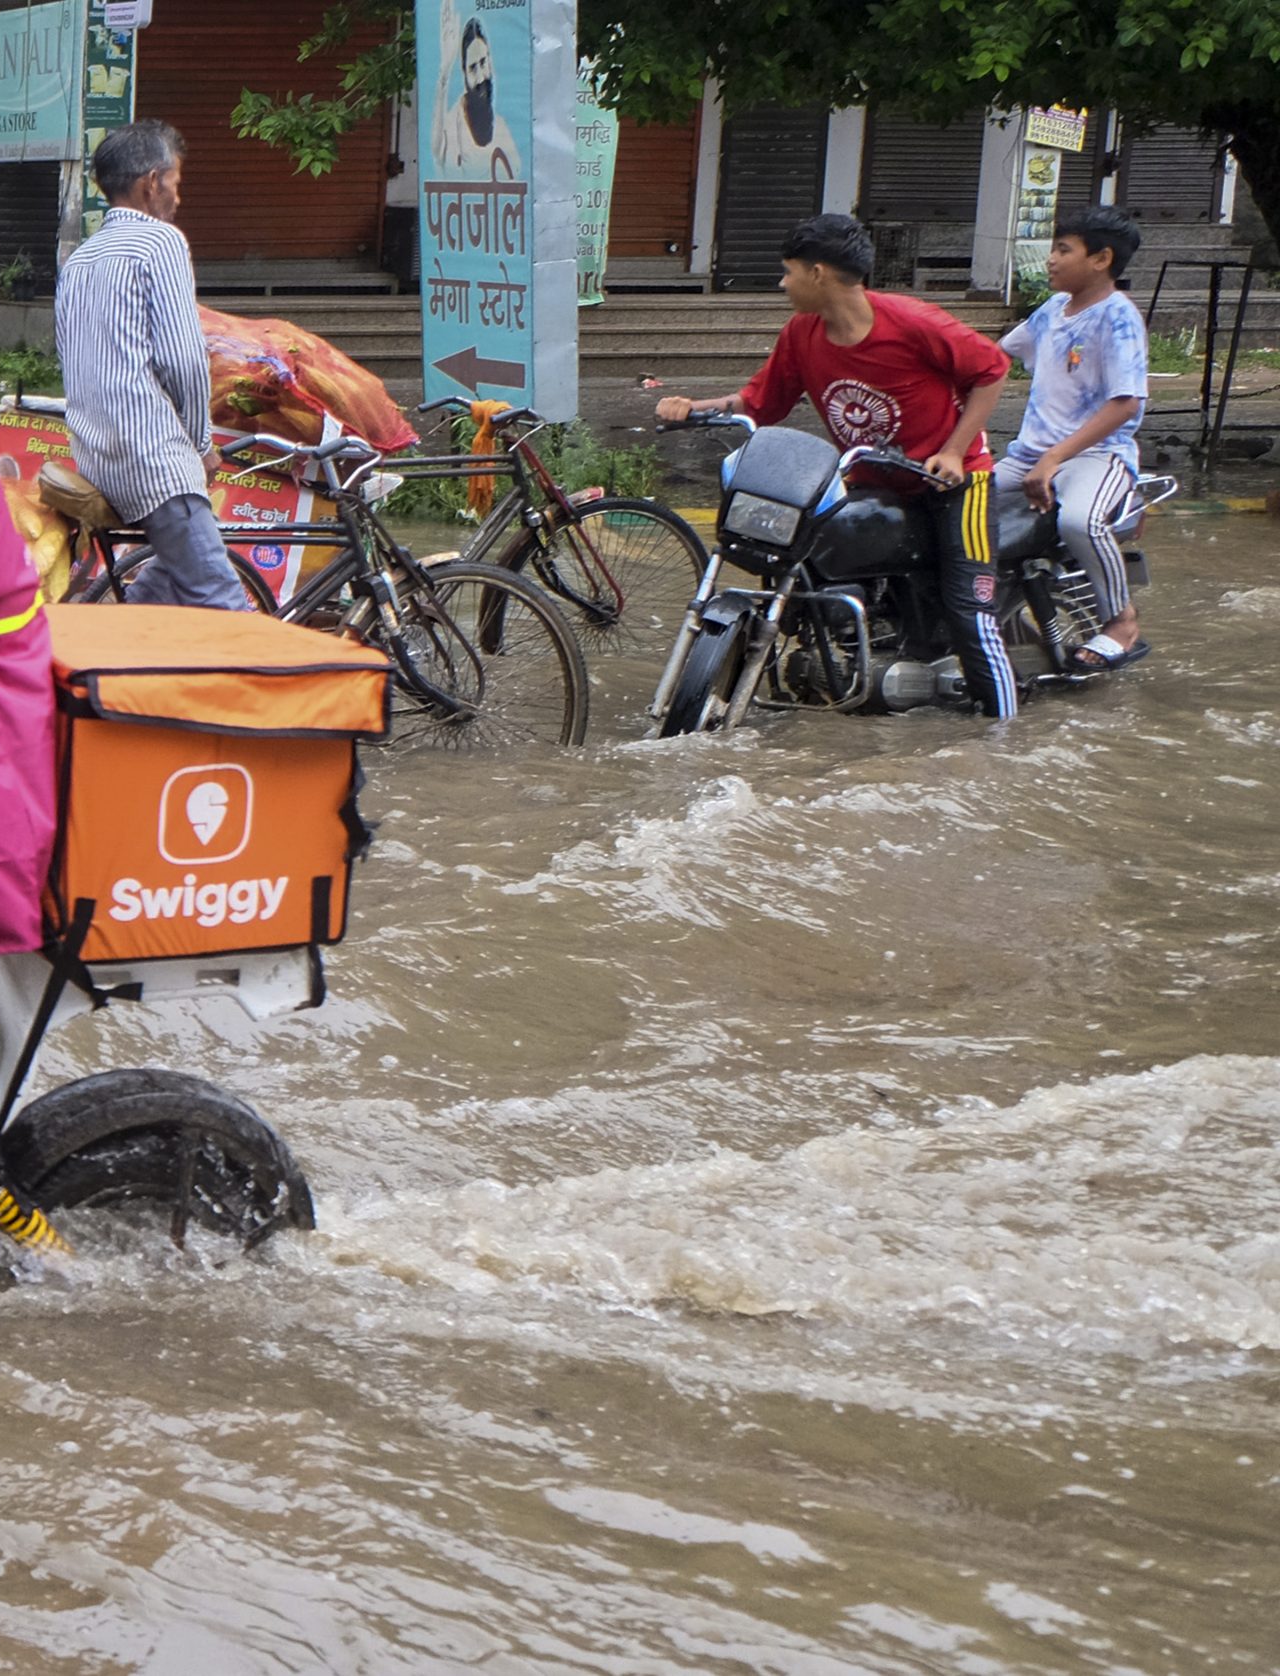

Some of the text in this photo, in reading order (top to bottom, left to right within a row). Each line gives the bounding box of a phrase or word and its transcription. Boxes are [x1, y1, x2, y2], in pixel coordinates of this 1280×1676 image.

[427, 257, 528, 331] मेगा स्टोर
[109, 872, 290, 928] Swiggy
